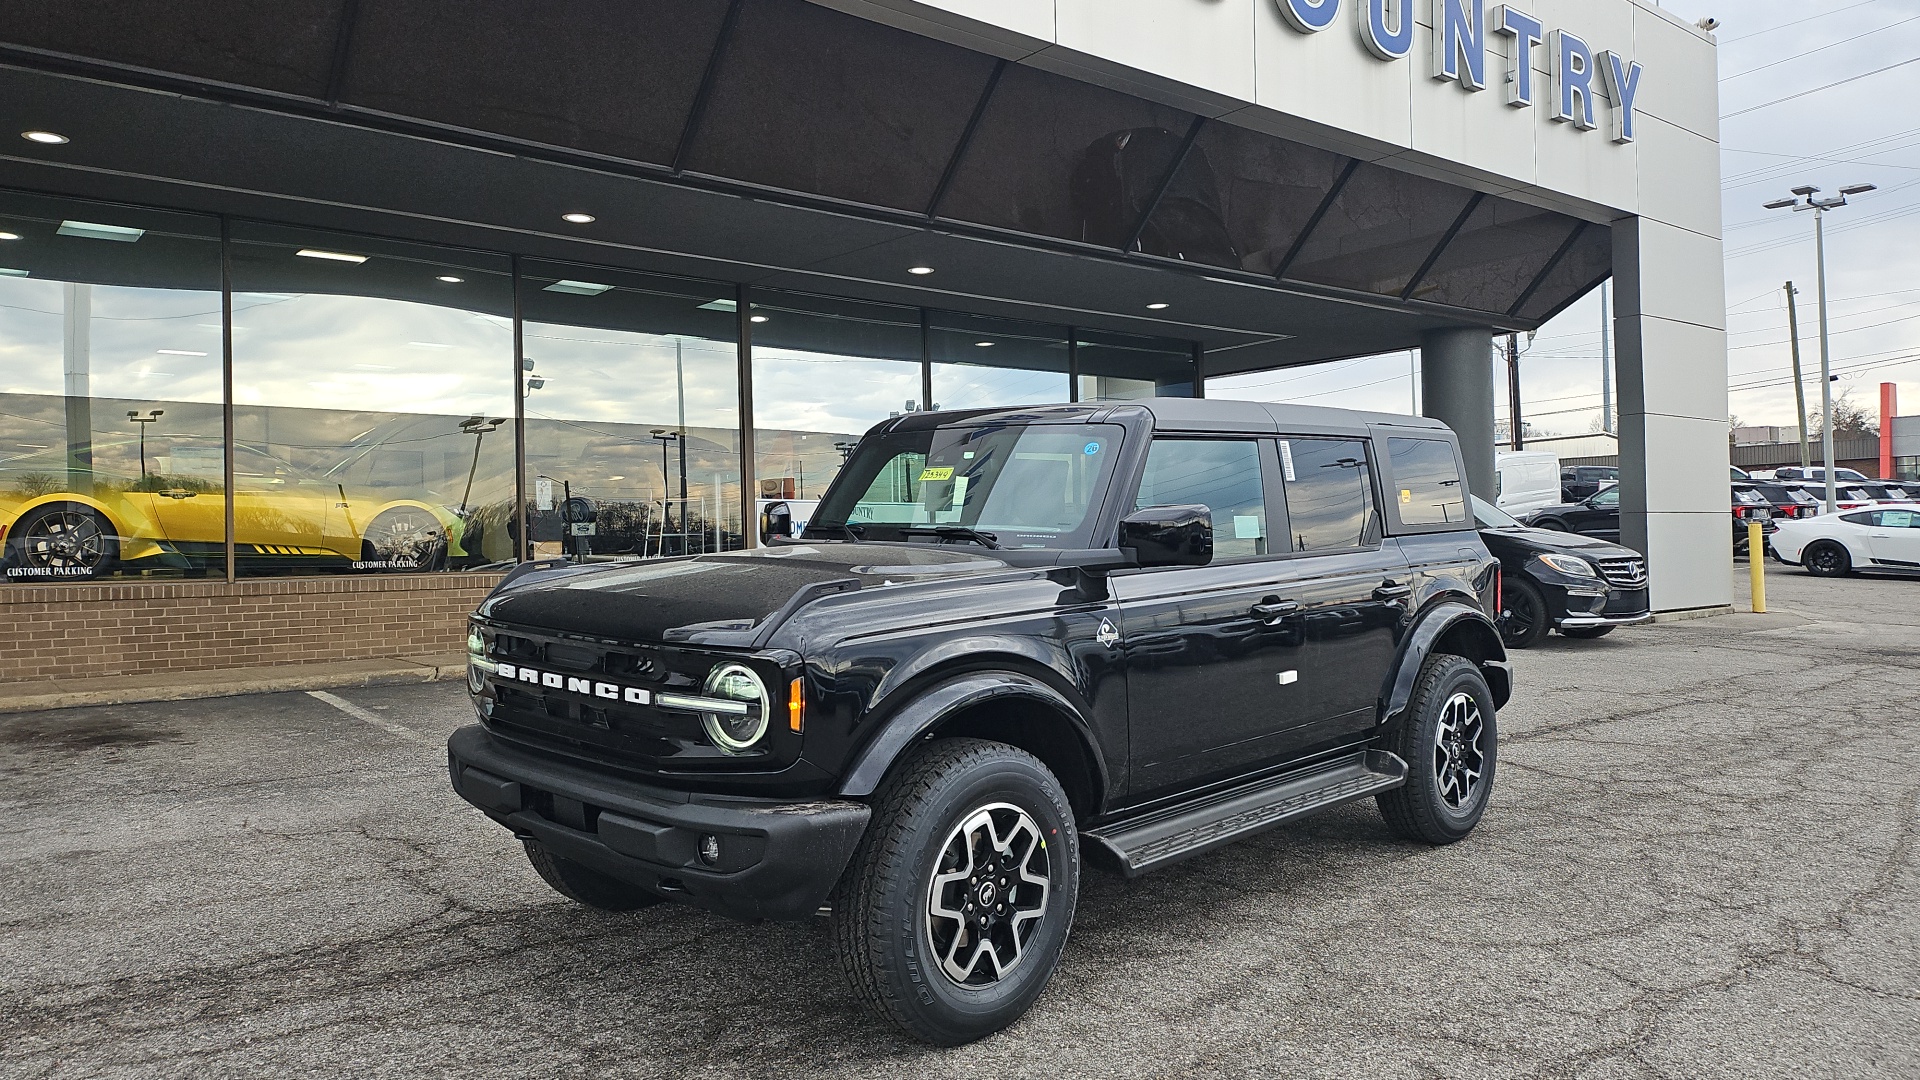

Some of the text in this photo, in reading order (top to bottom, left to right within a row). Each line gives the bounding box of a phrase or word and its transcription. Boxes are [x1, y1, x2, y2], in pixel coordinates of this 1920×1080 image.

[352, 560, 418, 569] CUSTOMER PARKING
[6, 566, 93, 577] CUSTOMER PARKING
[498, 663, 650, 705] BRONCO
